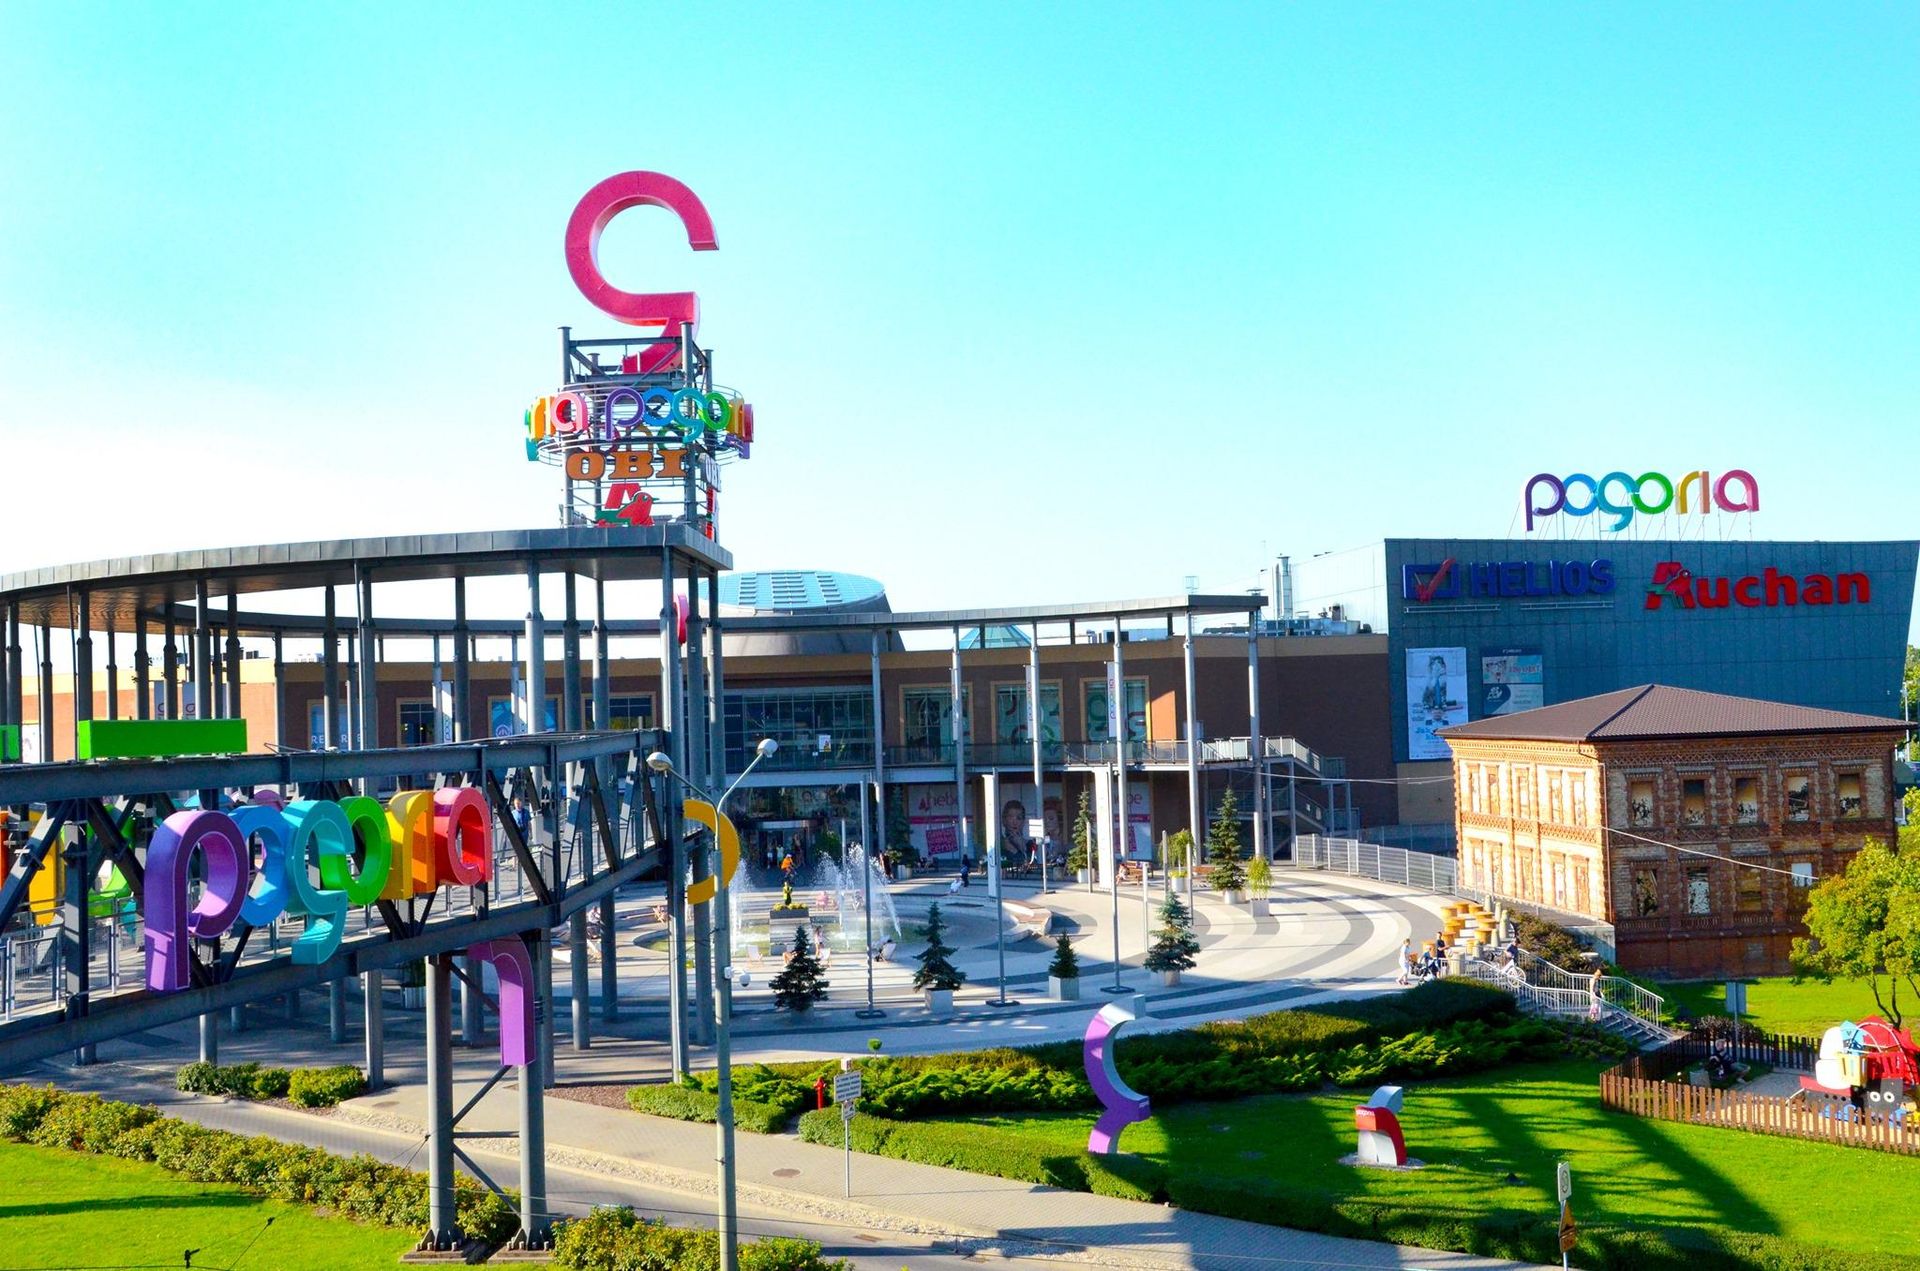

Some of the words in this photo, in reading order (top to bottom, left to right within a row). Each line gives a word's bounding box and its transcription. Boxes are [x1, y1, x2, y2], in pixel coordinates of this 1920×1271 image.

[565, 449, 688, 481] OBI
[1523, 469, 1761, 532] pogoria
[1470, 558, 1616, 599] HELIOS
[1645, 561, 1872, 610] Auchan
[144, 786, 494, 991] pogoria
